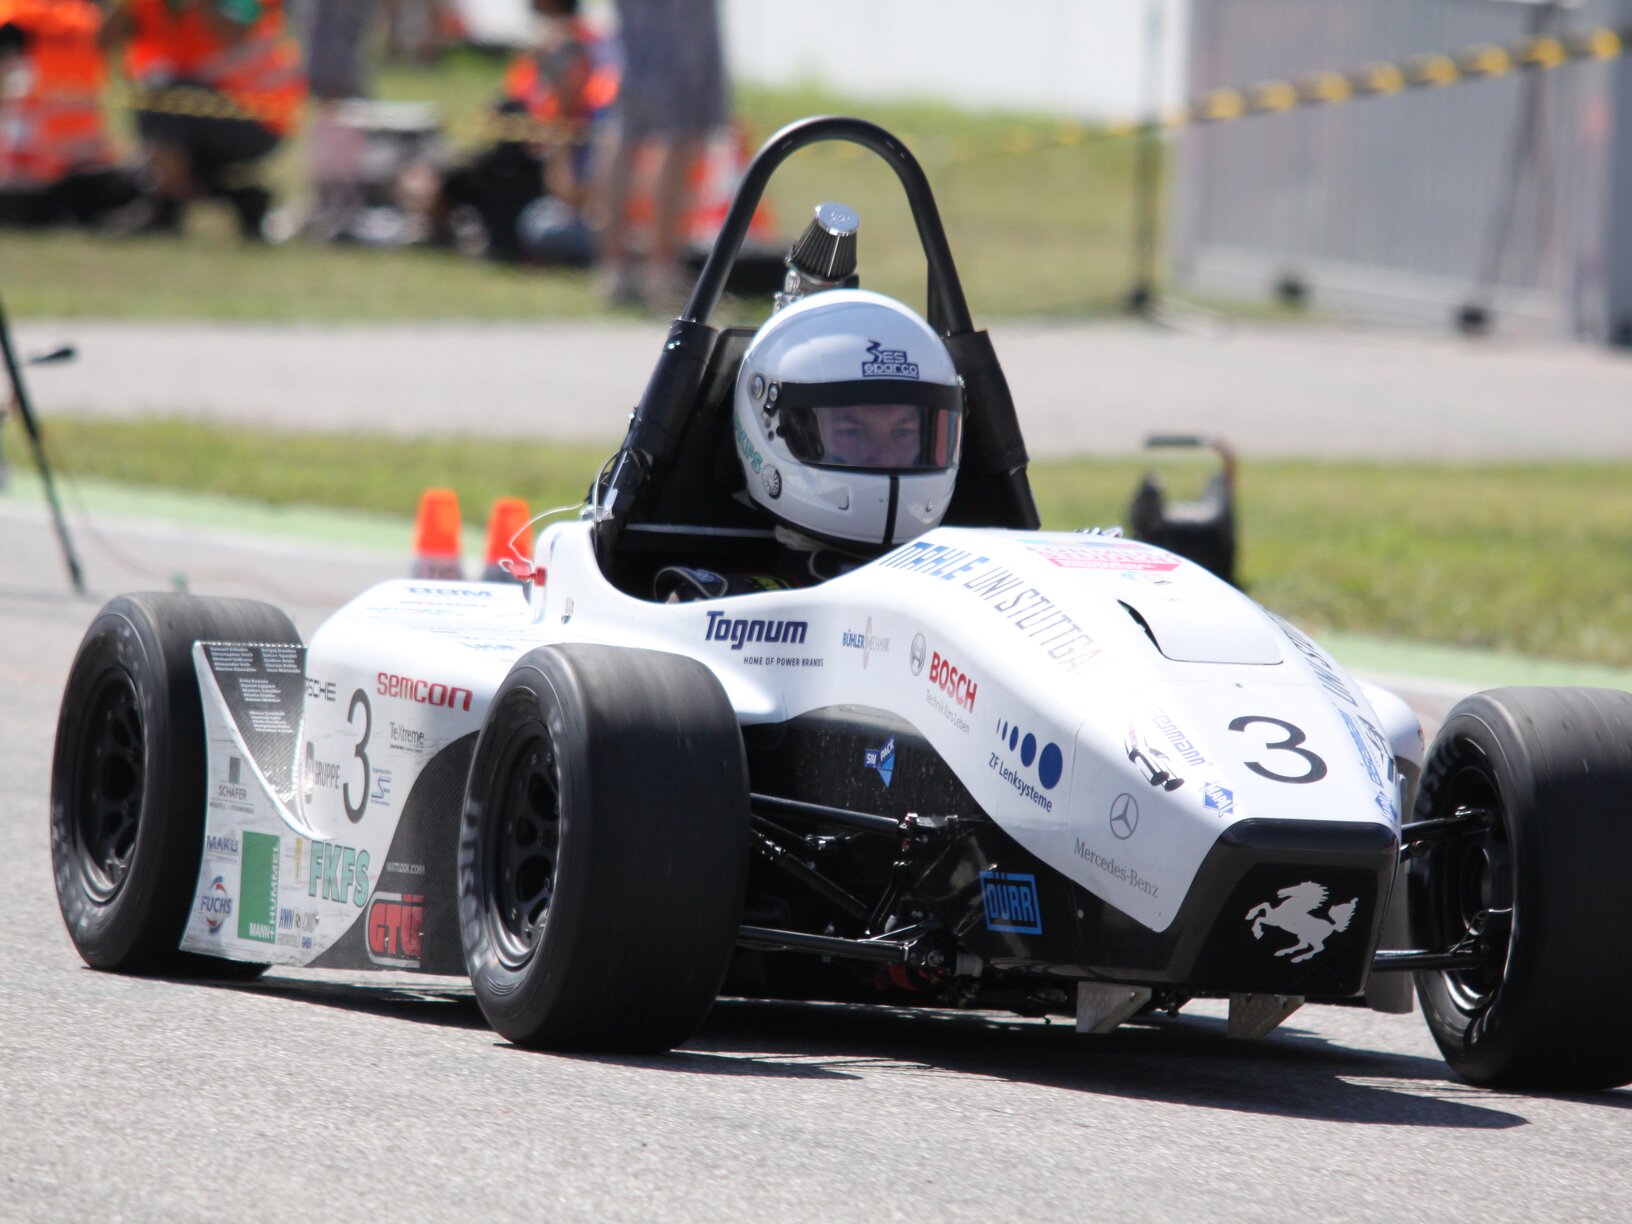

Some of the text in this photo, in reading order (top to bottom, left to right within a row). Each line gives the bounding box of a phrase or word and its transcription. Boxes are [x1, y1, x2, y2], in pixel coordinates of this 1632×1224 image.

[863, 363, 919, 376] sparco
[705, 610, 808, 650] Tognum
[878, 541, 991, 580] MAHLE
[963, 566, 1024, 601] UNI
[994, 588, 1106, 675] STUTTGA
[744, 656, 824, 668] HOME OF POWER BRANDS
[842, 629, 864, 650] BÜHLER
[376, 671, 473, 712] semcon
[925, 689, 945, 714] Technik
[953, 713, 970, 735] Leben
[929, 651, 978, 714] BOSCH
[343, 688, 373, 824] 3
[1228, 715, 1328, 784] 3
[988, 752, 1053, 813] ZF Lenksysteme
[249, 842, 280, 940] MANN+ HUMMEL
[308, 840, 371, 908] FKFS
[1073, 837, 1160, 899] Mercedes-Benz
[201, 895, 233, 914] FUCHS
